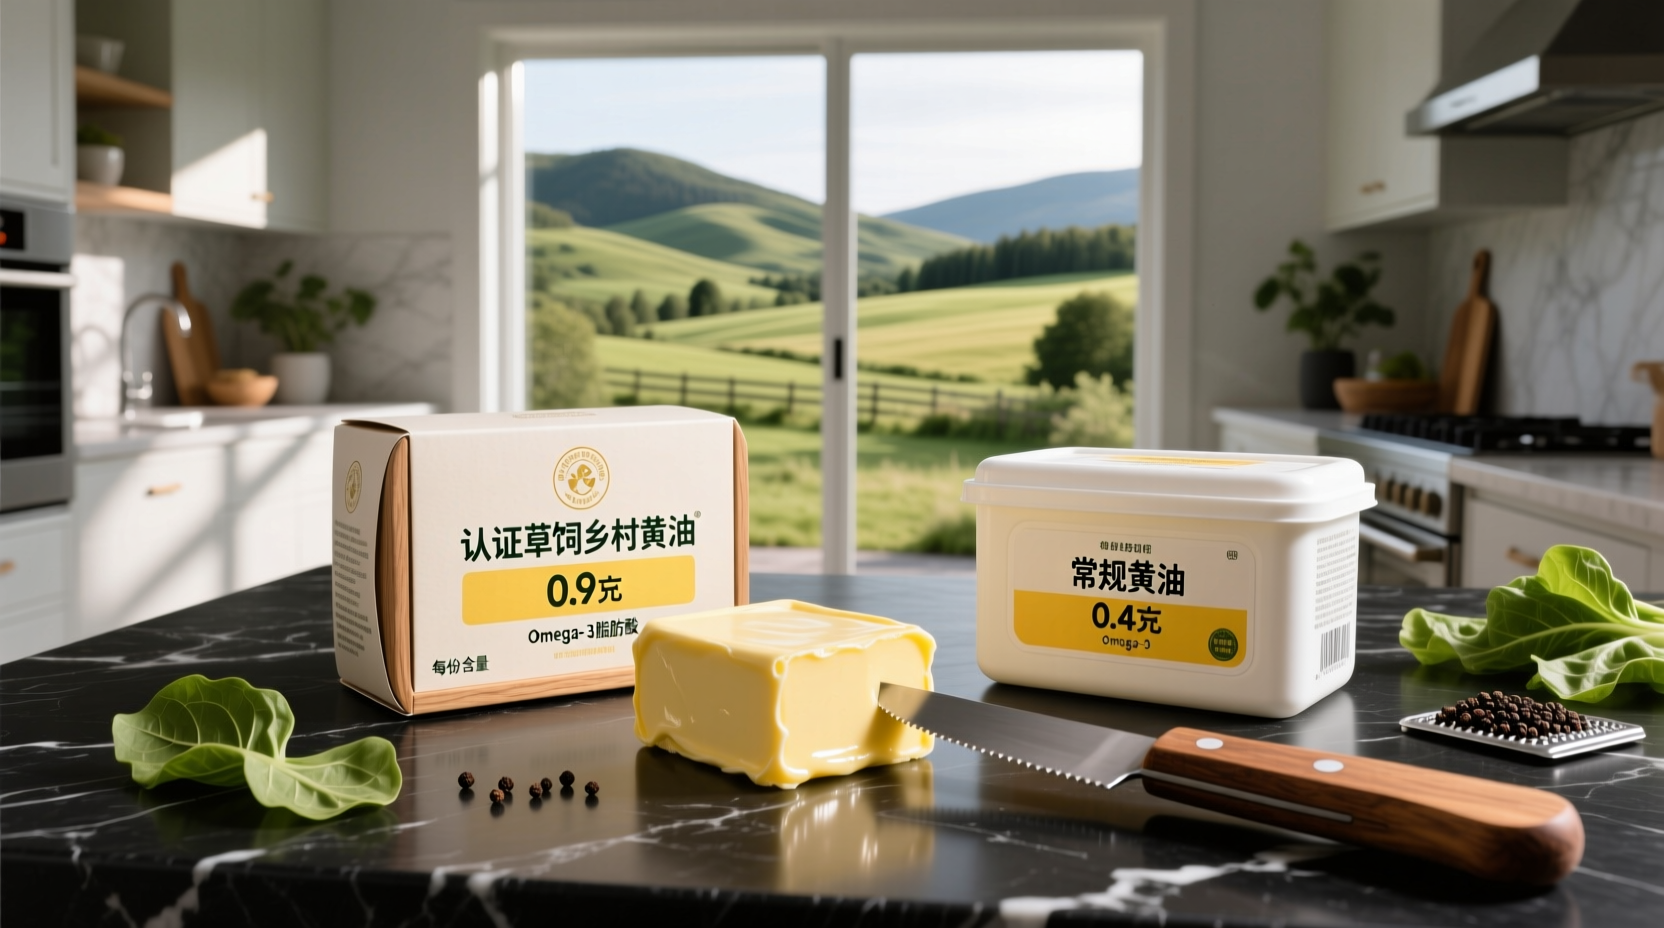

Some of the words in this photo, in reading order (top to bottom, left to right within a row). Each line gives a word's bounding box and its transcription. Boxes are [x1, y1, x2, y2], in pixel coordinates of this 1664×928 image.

[460, 514, 696, 562] 认证草饲乡村黄油
[1071, 556, 1185, 597] 常规黄油
[432, 654, 490, 677] 每份含量
